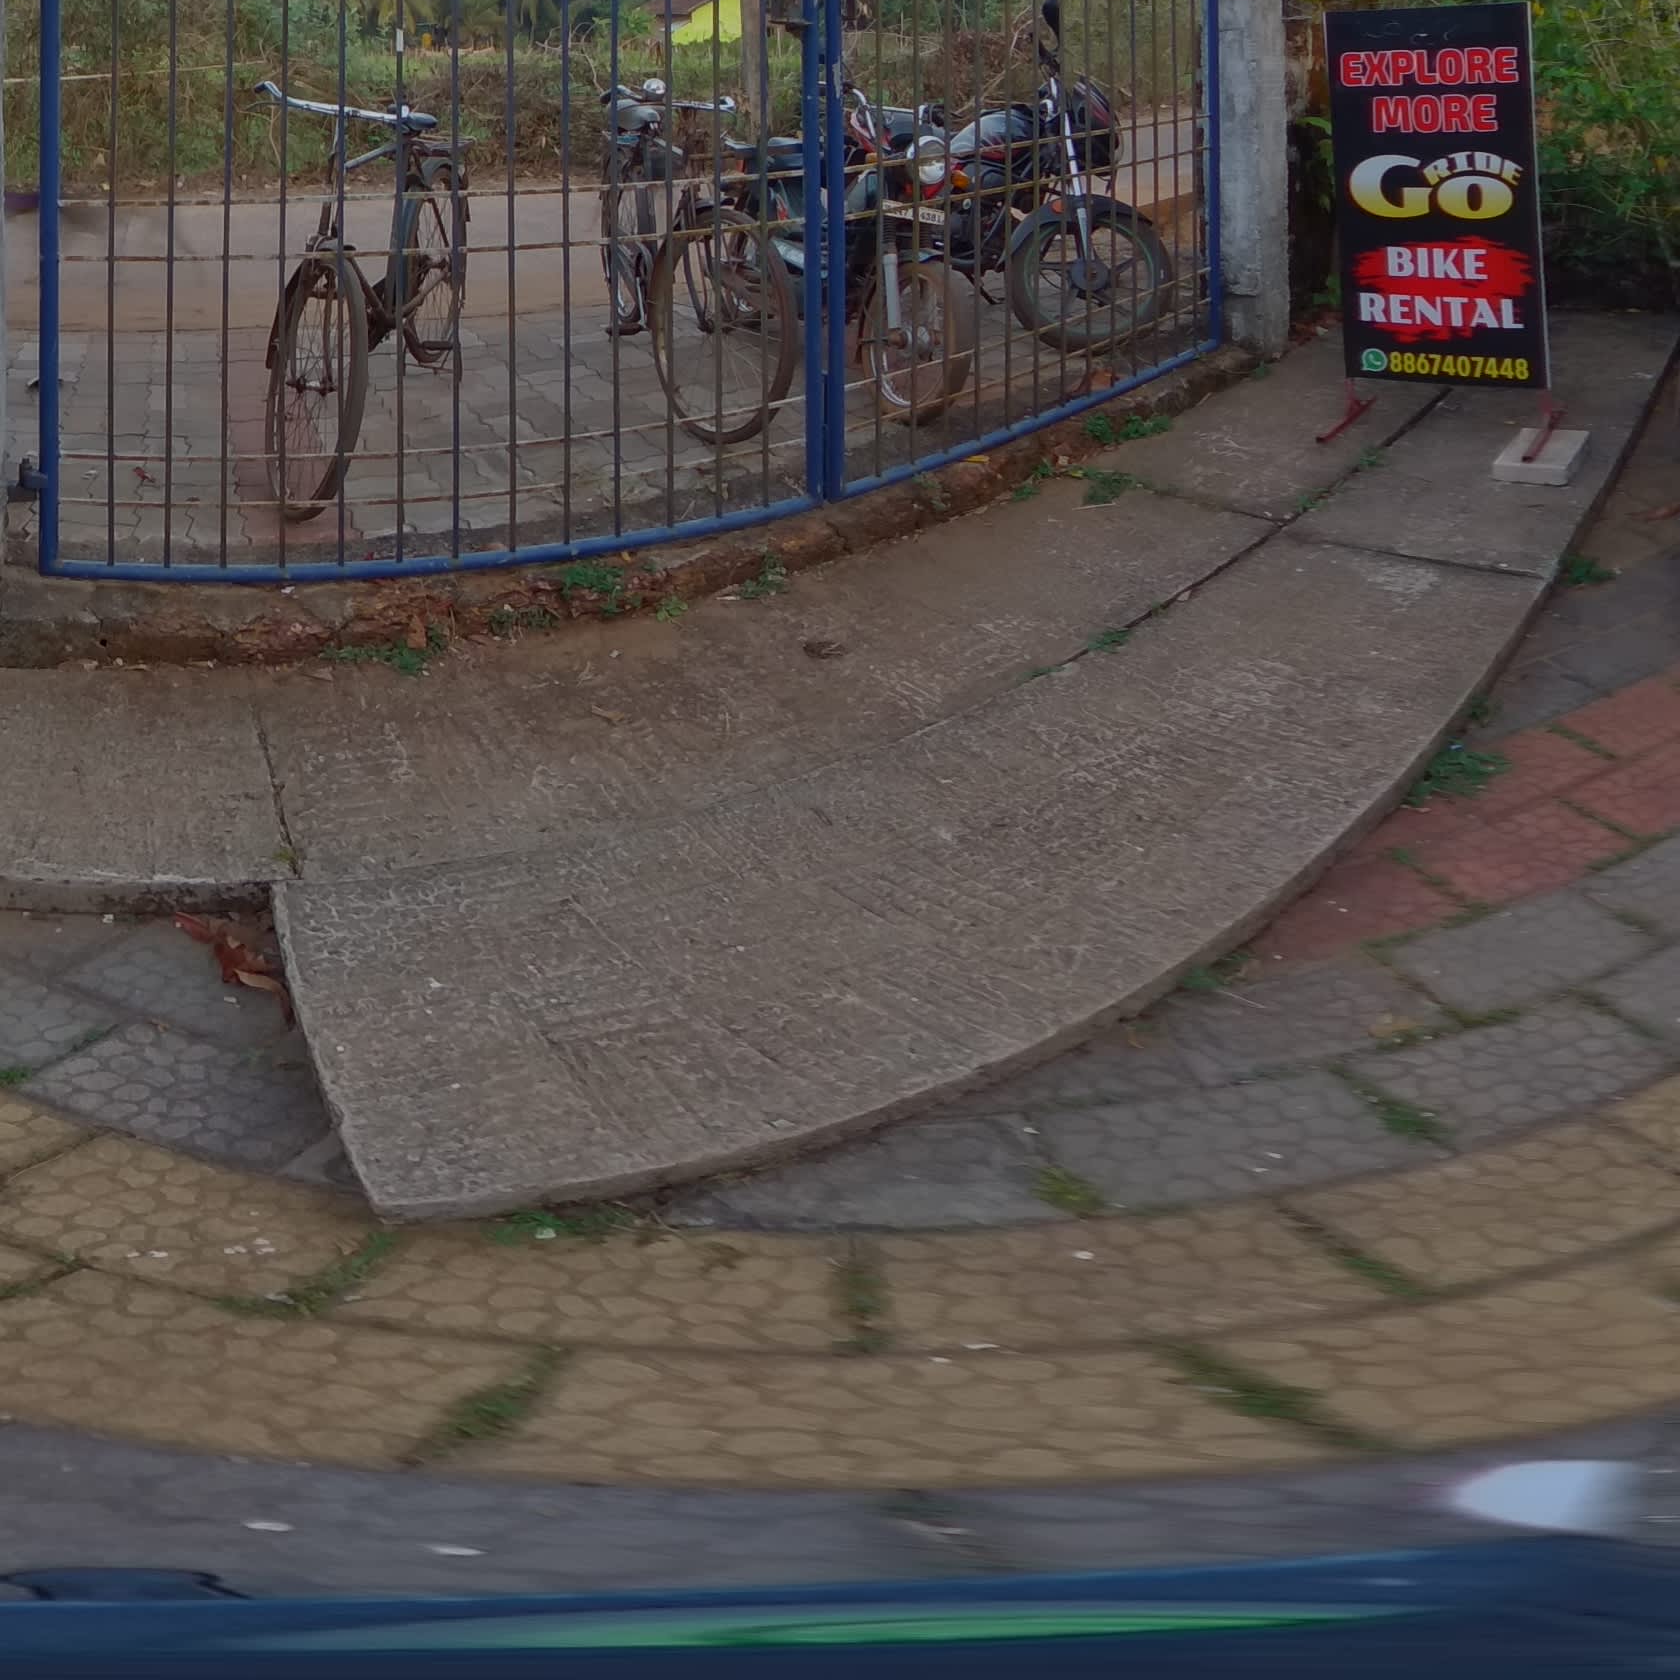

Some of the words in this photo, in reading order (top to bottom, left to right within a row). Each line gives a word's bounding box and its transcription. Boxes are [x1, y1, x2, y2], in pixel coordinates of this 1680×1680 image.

[1340, 46, 1519, 87] EXPLORE
[1372, 94, 1498, 134] MORE
[1350, 153, 1514, 220] GO
[1423, 151, 1524, 187] RIDE
[1386, 246, 1489, 280] BIKE
[1358, 292, 1525, 329] RENTAL
[1389, 351, 1529, 380] 8867407448
